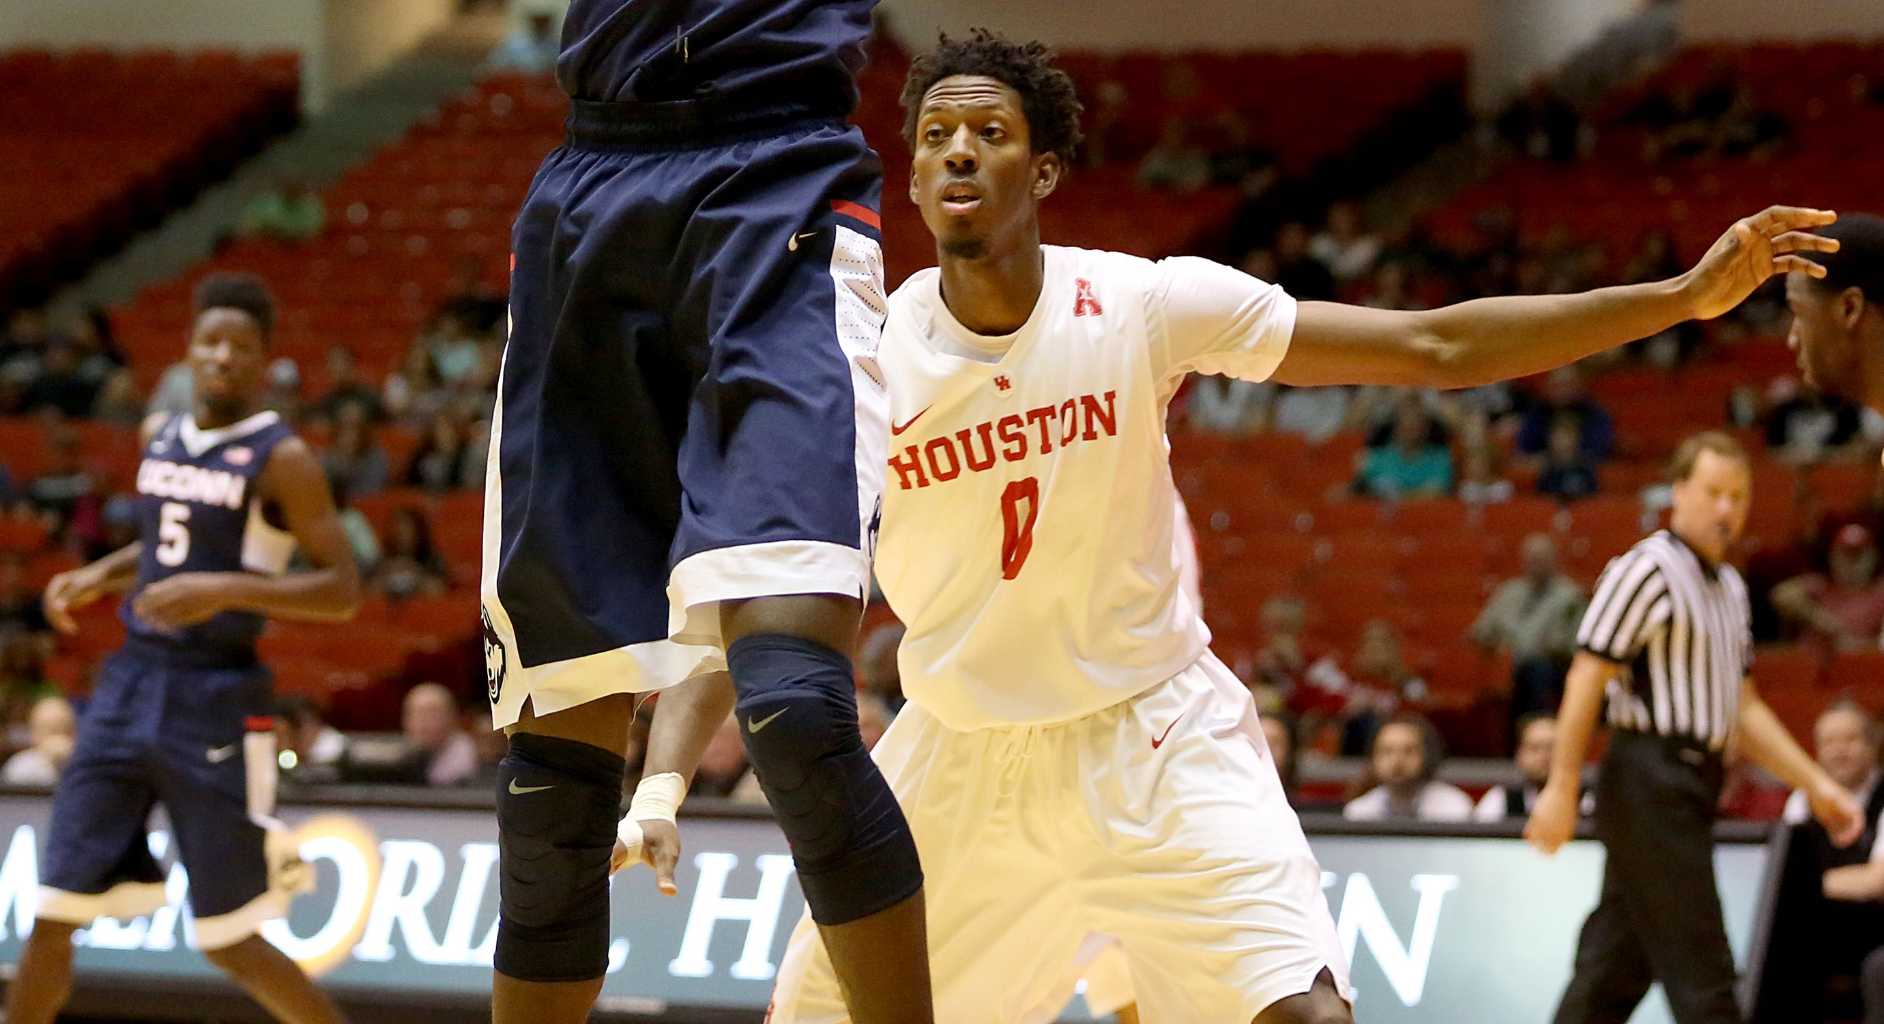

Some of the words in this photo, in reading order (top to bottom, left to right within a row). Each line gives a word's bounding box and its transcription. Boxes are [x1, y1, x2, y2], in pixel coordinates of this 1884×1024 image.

[888, 390, 1117, 490] HOUSTON
[156, 501, 191, 567] 5
[1000, 476, 1039, 581] 0
